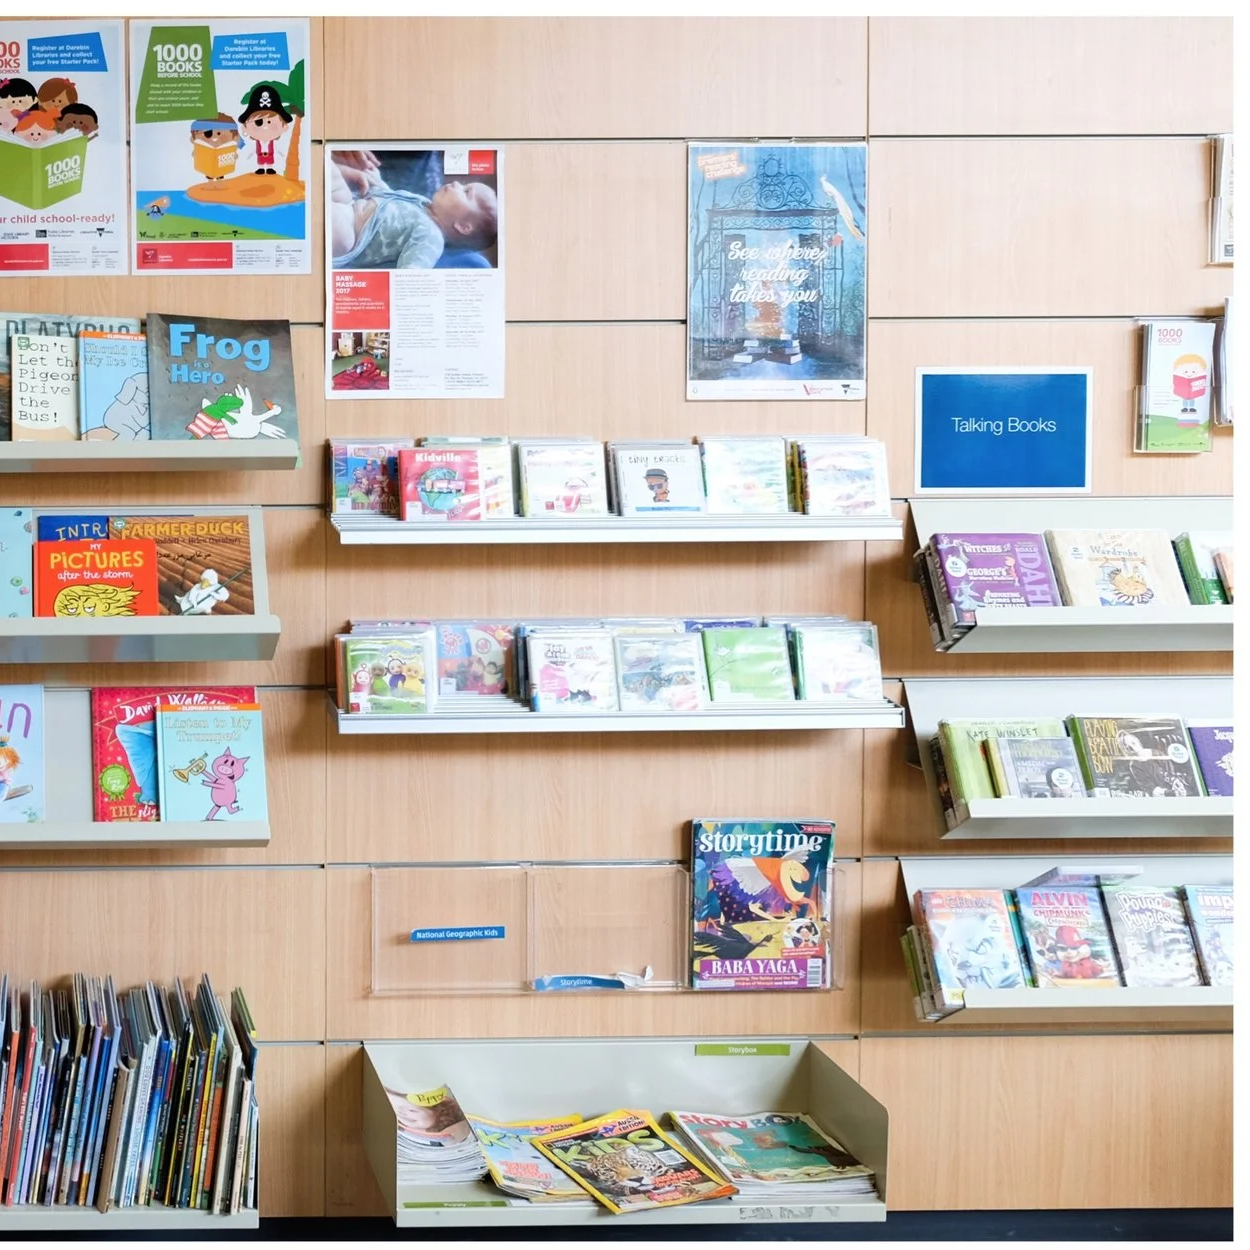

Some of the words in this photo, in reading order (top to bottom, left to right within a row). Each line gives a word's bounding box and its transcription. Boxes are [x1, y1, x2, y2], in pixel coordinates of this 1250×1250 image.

[153, 44, 202, 62] 1000
[158, 62, 202, 72] BOOKS
[45, 155, 81, 177] 1000
[48, 167, 81, 184] BOOKS
[11, 215, 37, 223] child
[41, 214, 115, 224] school-ready!
[728, 241, 759, 261] See
[766, 239, 828, 263] where
[739, 259, 809, 287] reading
[730, 283, 775, 303] takes
[780, 288, 818, 308] you
[1157, 329, 1183, 338] 1000
[169, 323, 271, 372] Frog
[19, 355, 47, 366] Let
[19, 369, 79, 381] Pigeon
[170, 363, 225, 385] Hero
[19, 382, 71, 395] Drive
[20, 397, 50, 408] the
[19, 410, 58, 422] Bus!
[951, 417, 1003, 435] Talking
[1007, 418, 1056, 432] Books
[415, 452, 462, 463] Kidville
[121, 522, 194, 541] FARMER
[196, 521, 245, 535] DUCK
[57, 570, 80, 582] after
[83, 570, 100, 579] the
[103, 570, 133, 579] storm
[109, 805, 136, 818] THE
[699, 828, 823, 856] storytime
[1032, 891, 1088, 906] ALVIN
[416, 930, 444, 939] National
[445, 929, 482, 940] Geographic
[483, 928, 498, 937] Kids
[711, 960, 755, 974] BABA
[755, 959, 798, 974] YAGA
[560, 978, 592, 987] Storytime
[728, 1046, 757, 1054] Storybox
[678, 1113, 749, 1129] story
